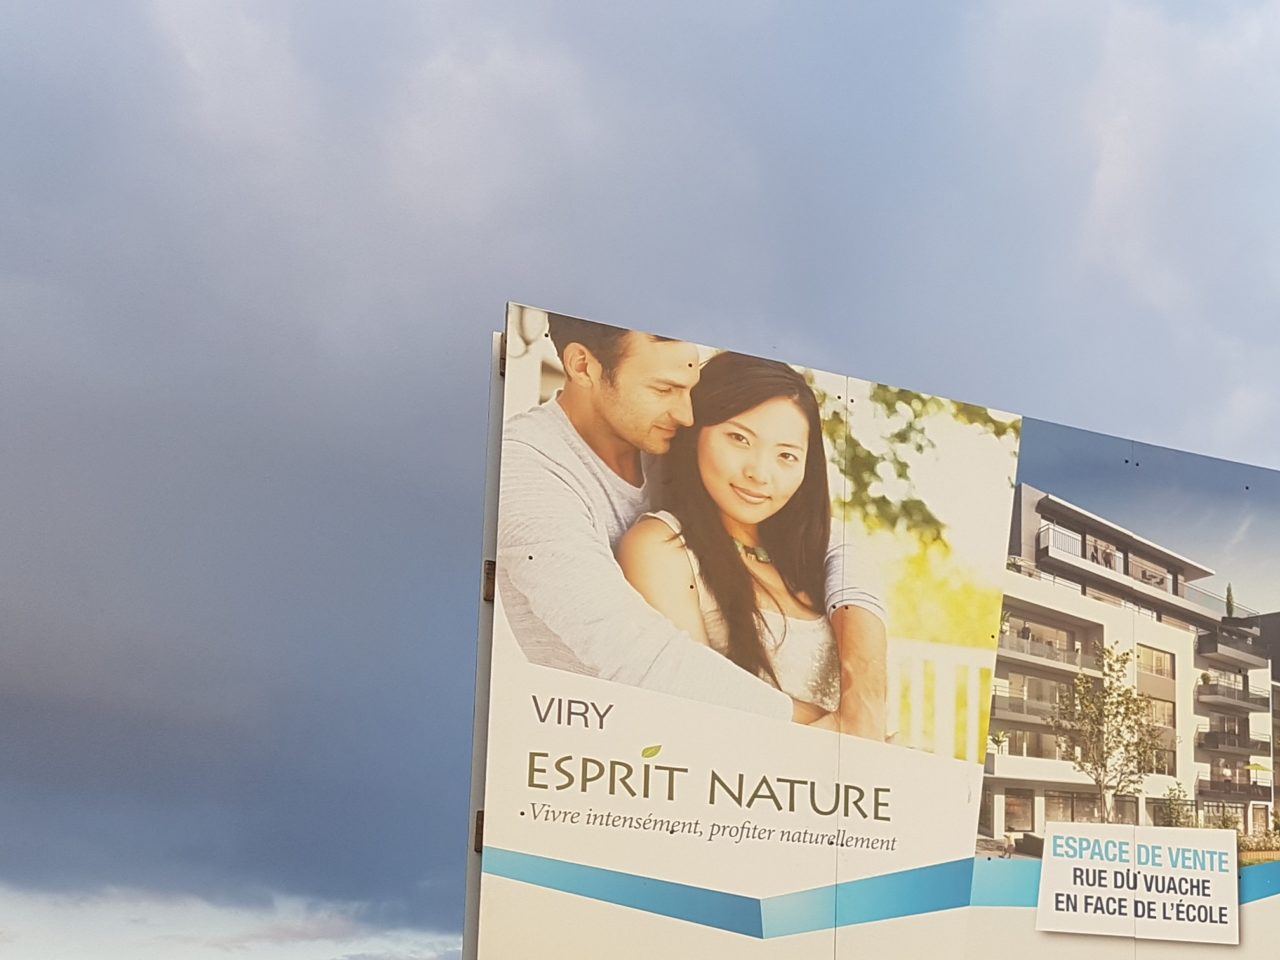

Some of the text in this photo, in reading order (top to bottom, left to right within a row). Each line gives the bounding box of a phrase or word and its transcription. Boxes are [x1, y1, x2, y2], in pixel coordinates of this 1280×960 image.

[532, 695, 613, 729] VIRY
[527, 746, 890, 821] ESPRIT NATURE
[529, 802, 897, 852] Vivre intensément, profiter naturellement
[1052, 835, 1230, 873] ESPACE DE VENTE
[1072, 867, 1211, 897] RUE DU VUACHE
[1054, 893, 1078, 913] EN
[1083, 895, 1128, 917] FACE
[1134, 900, 1157, 919] DE
